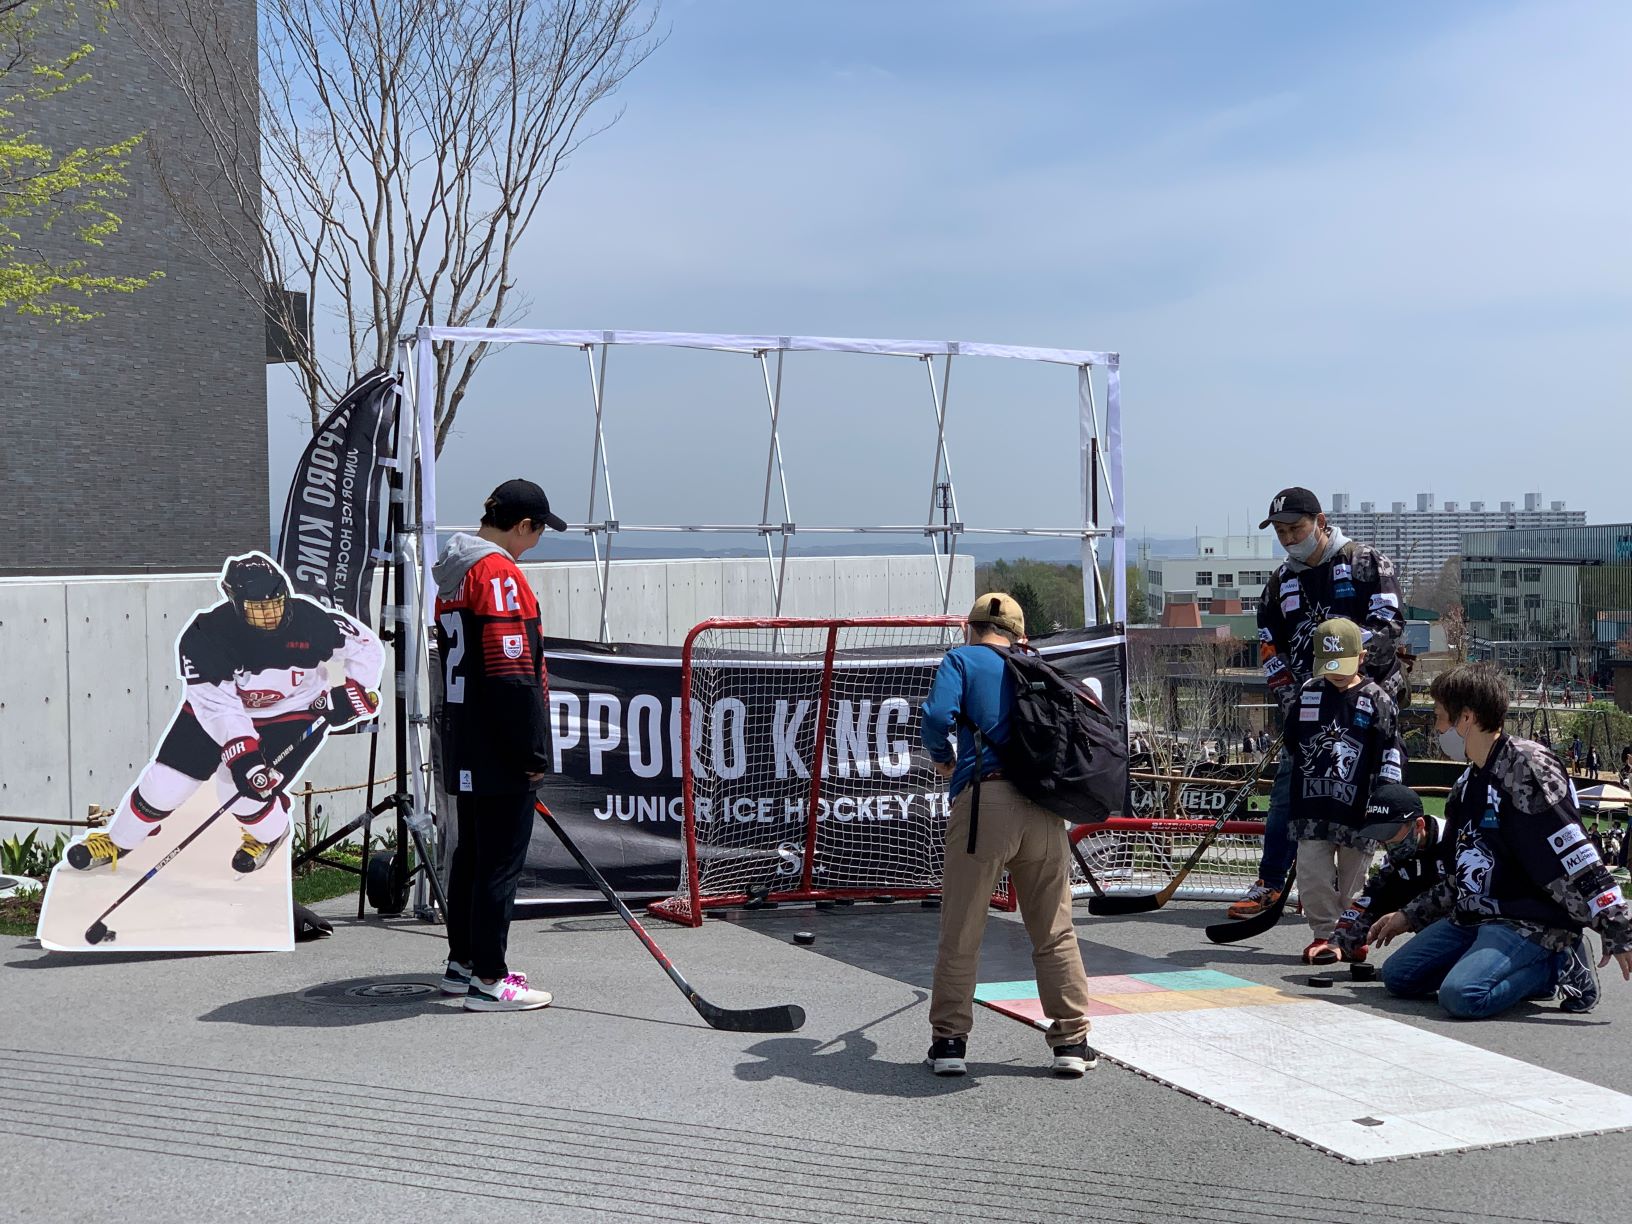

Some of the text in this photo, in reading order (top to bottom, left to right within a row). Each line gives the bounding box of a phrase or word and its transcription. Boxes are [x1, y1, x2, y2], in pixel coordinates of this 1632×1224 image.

[1274, 496, 1286, 512] W
[490, 576, 520, 611] 12
[291, 671, 304, 686] C
[1306, 779, 1355, 803] KINGS
[594, 795, 713, 822] JUNIOR
[724, 796, 775, 823] ICE
[784, 794, 915, 822] HOCKEY
[1215, 778, 1256, 830] EASTON
[1367, 805, 1389, 815] JAPAN
[500, 988, 517, 1001] N
